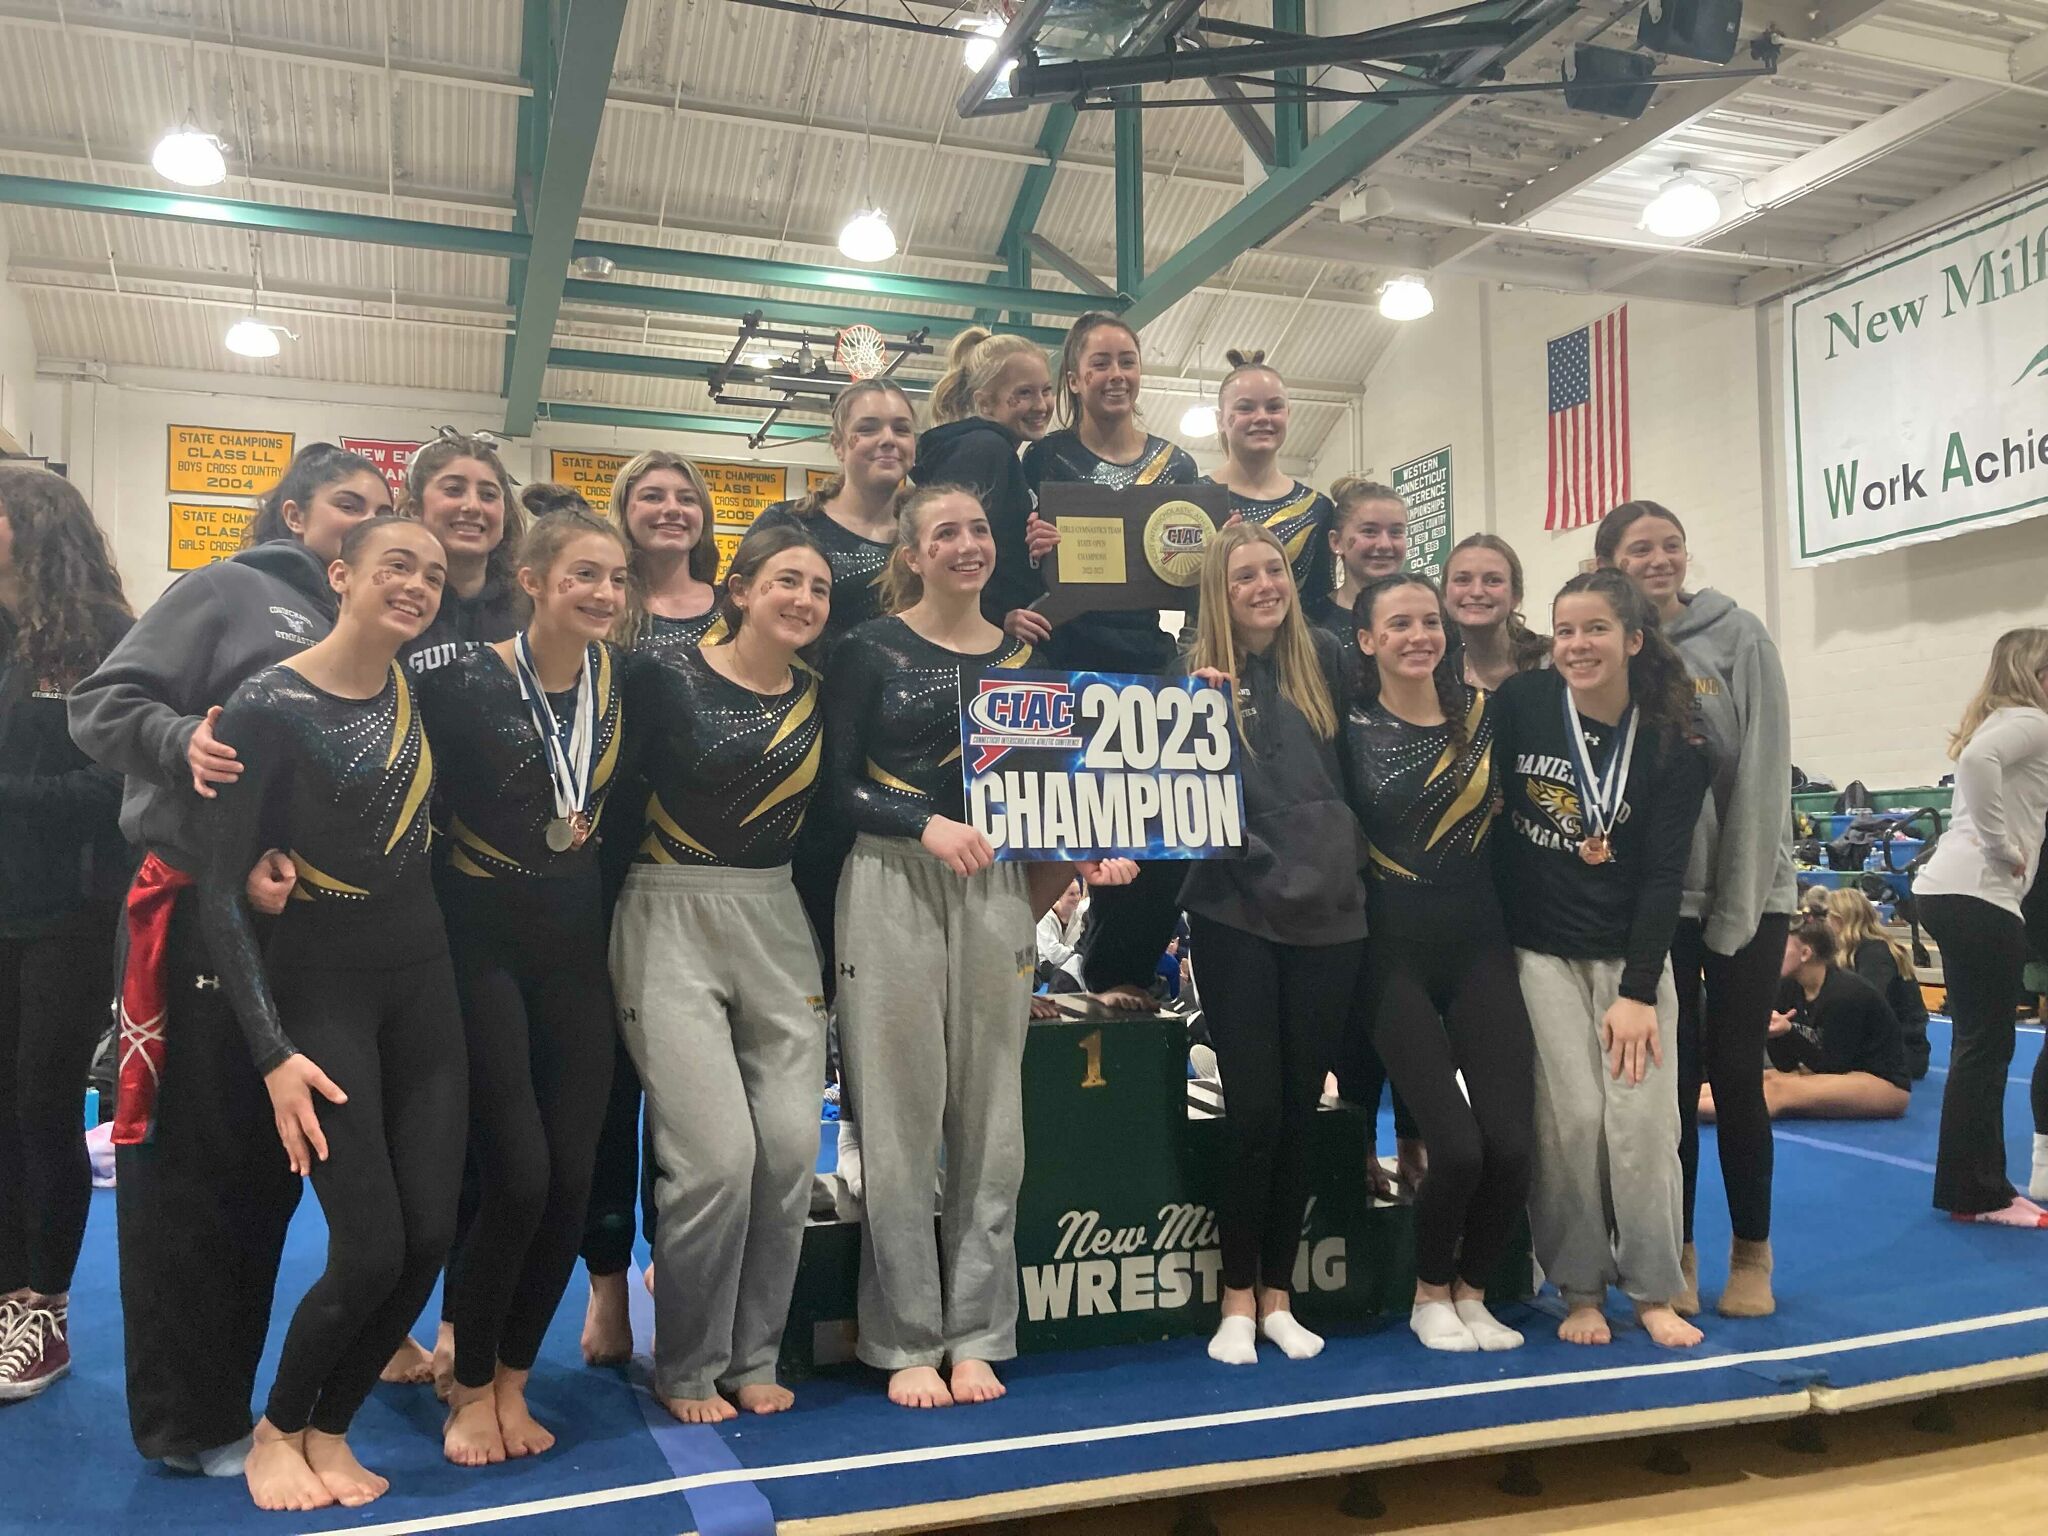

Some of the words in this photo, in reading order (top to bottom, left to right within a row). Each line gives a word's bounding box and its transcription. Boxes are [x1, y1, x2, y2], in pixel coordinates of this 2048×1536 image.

[1824, 294, 1929, 360] New
[1941, 225, 2048, 318] Milf
[179, 432, 214, 444] STATE
[220, 435, 283, 449] CHAMPIONS
[187, 447, 247, 460] CLASS
[252, 450, 275, 462] LL
[177, 460, 202, 473] BOYS
[206, 462, 237, 474] CROSS
[241, 464, 283, 477] COUNTRY
[562, 457, 593, 469] STATE
[1402, 456, 1439, 481] WESTERN
[573, 471, 617, 484] CLAS
[725, 470, 777, 483] CHAMPIONS
[1395, 467, 1447, 496] CONNECTICUT
[1824, 459, 1927, 520] Work
[1941, 428, 2048, 493] Achie
[206, 477, 254, 490] 2004
[585, 485, 611, 498] CROSS
[756, 485, 766, 496] L
[714, 495, 740, 507] CROSS
[1406, 482, 1447, 507] NFERENCE
[182, 510, 217, 523] STATE
[195, 525, 242, 538] CLAS
[1167, 528, 1203, 544] CIAC
[178, 539, 205, 551] GIRLS
[209, 540, 239, 552] CROSS
[986, 692, 1075, 730] CIAC
[1081, 683, 1232, 771] 2023
[1516, 754, 1575, 786] DANIE
[970, 770, 1242, 849] CHAMPION
[1078, 1030, 1107, 1088] 1
[1053, 1209, 1147, 1260] New
